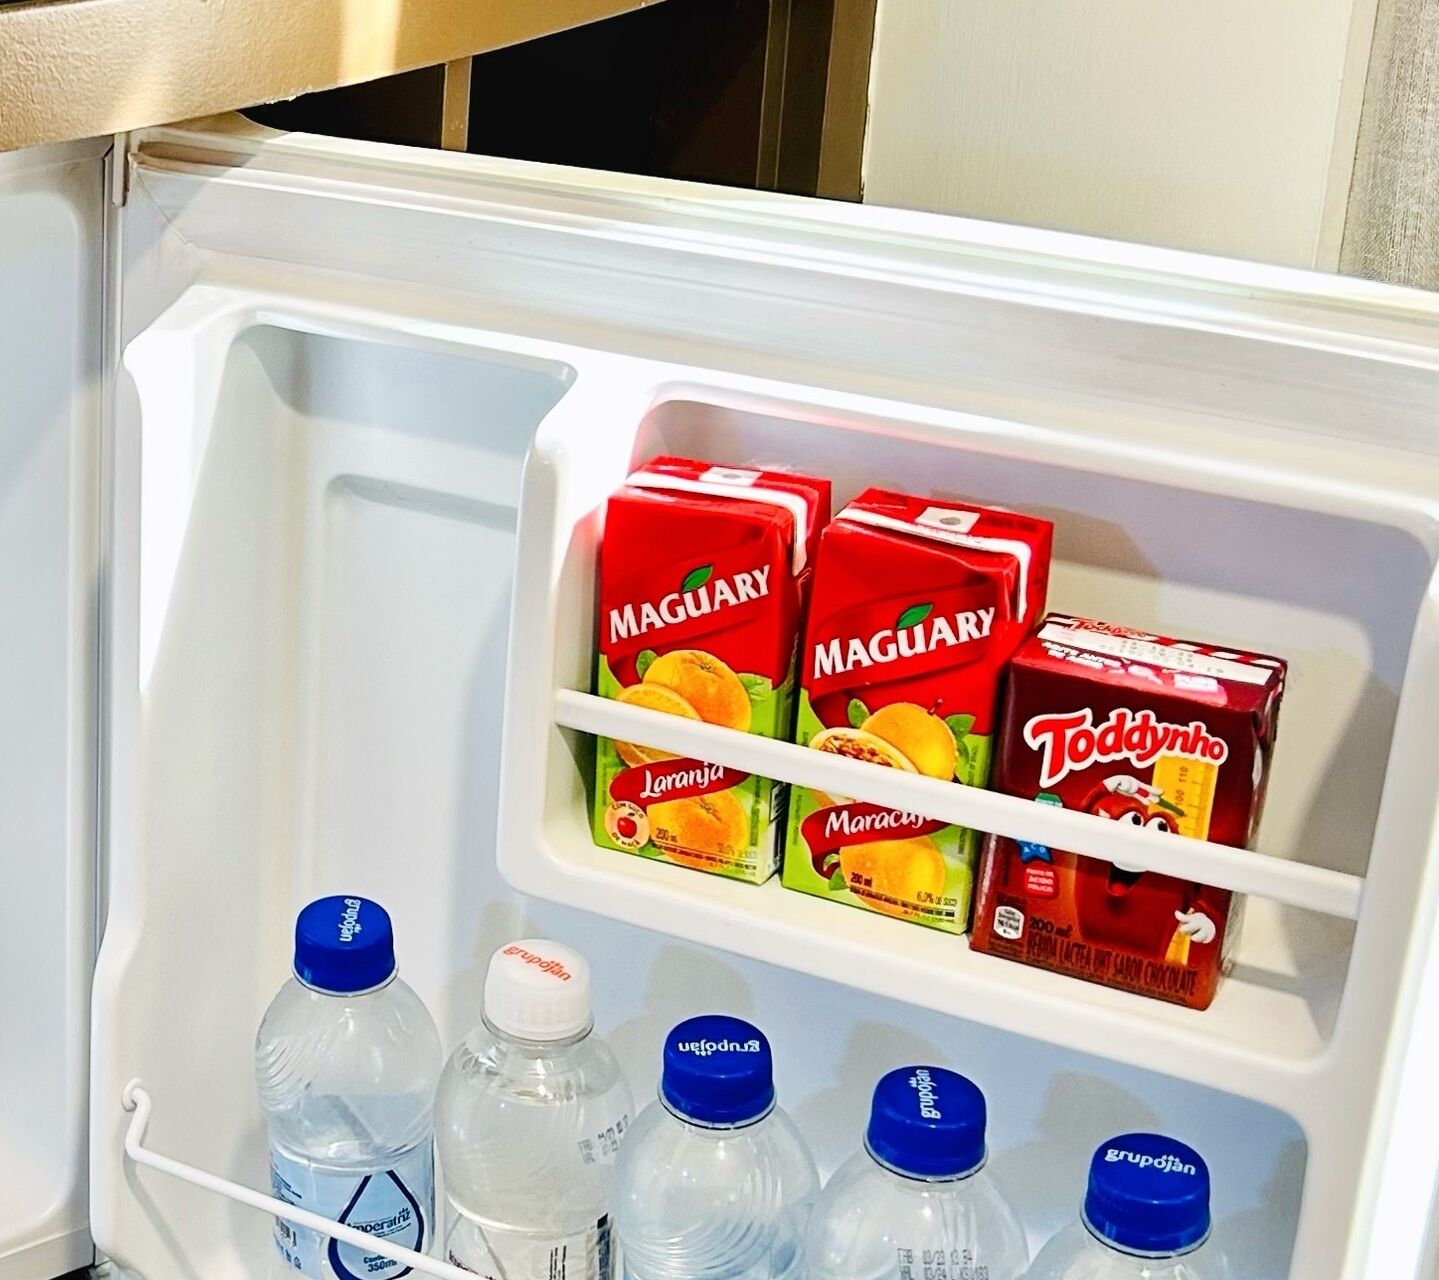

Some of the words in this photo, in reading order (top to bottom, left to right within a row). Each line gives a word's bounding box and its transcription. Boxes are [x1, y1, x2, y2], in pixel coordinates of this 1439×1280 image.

[609, 564, 770, 644] MAGUARY
[813, 606, 996, 680] MAGUARY
[640, 761, 724, 799] Laranja
[1025, 709, 1227, 787] Toddynho
[824, 809, 936, 839] Maracuj
